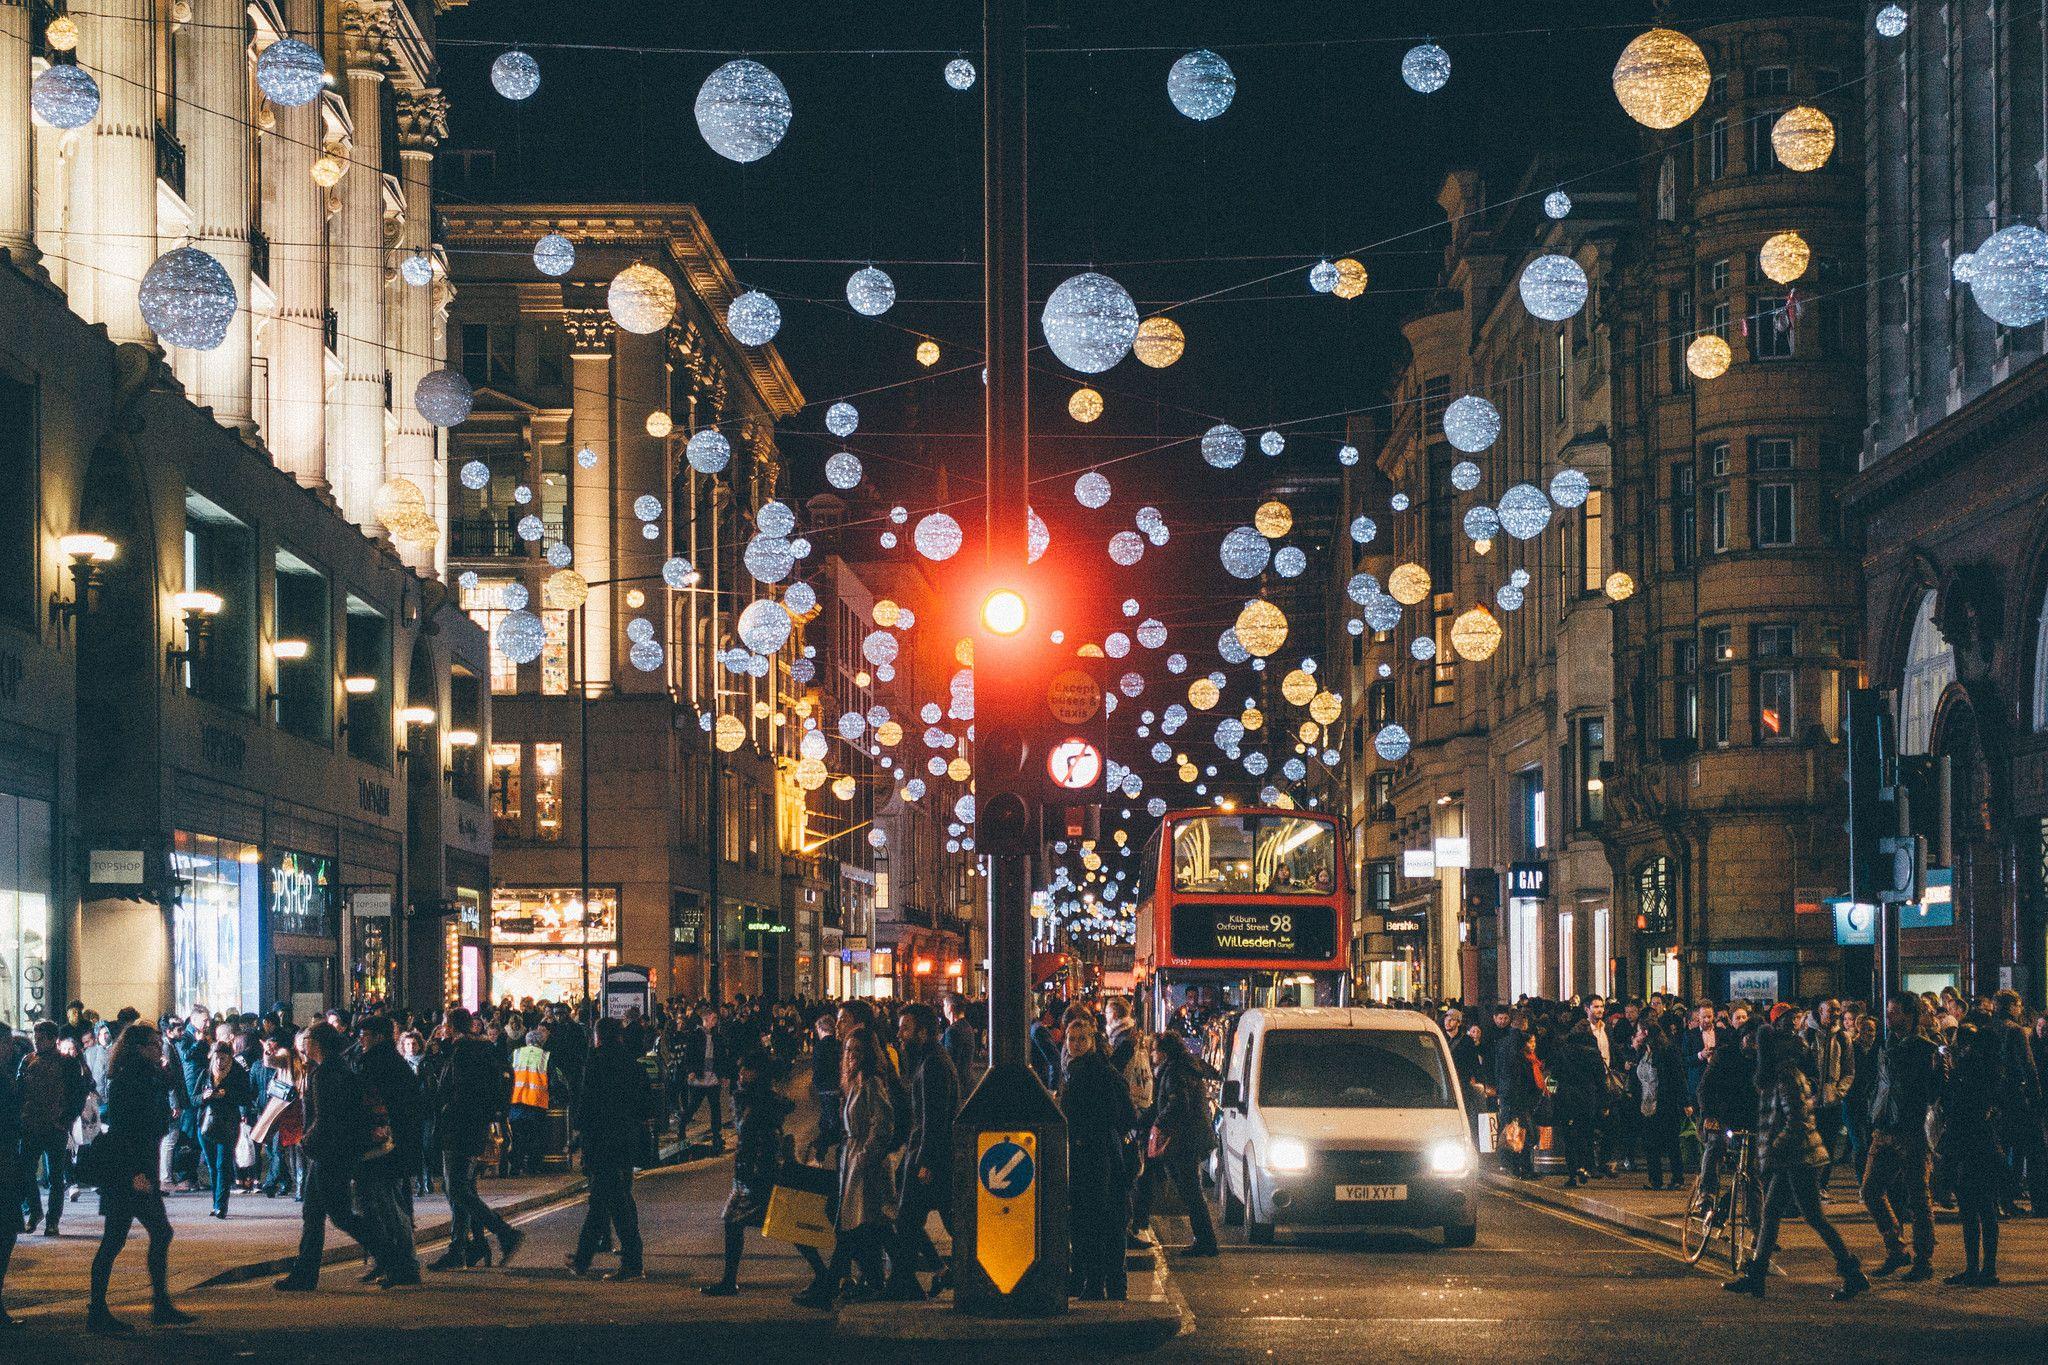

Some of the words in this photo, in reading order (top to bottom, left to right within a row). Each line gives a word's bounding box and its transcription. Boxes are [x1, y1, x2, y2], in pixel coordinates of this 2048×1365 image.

[1060, 709, 1088, 718] taxis
[95, 862, 141, 871] TOPSHOP
[1519, 870, 1543, 889] GAP
[1229, 915, 1257, 923] Kilburn
[1269, 915, 1292, 932] 98
[1216, 922, 1244, 931] Oxford
[1246, 923, 1269, 931] Street
[1386, 921, 1419, 931] Bershka
[1216, 935, 1277, 948] Willesden
[1373, 1187, 1397, 1199] XYT
